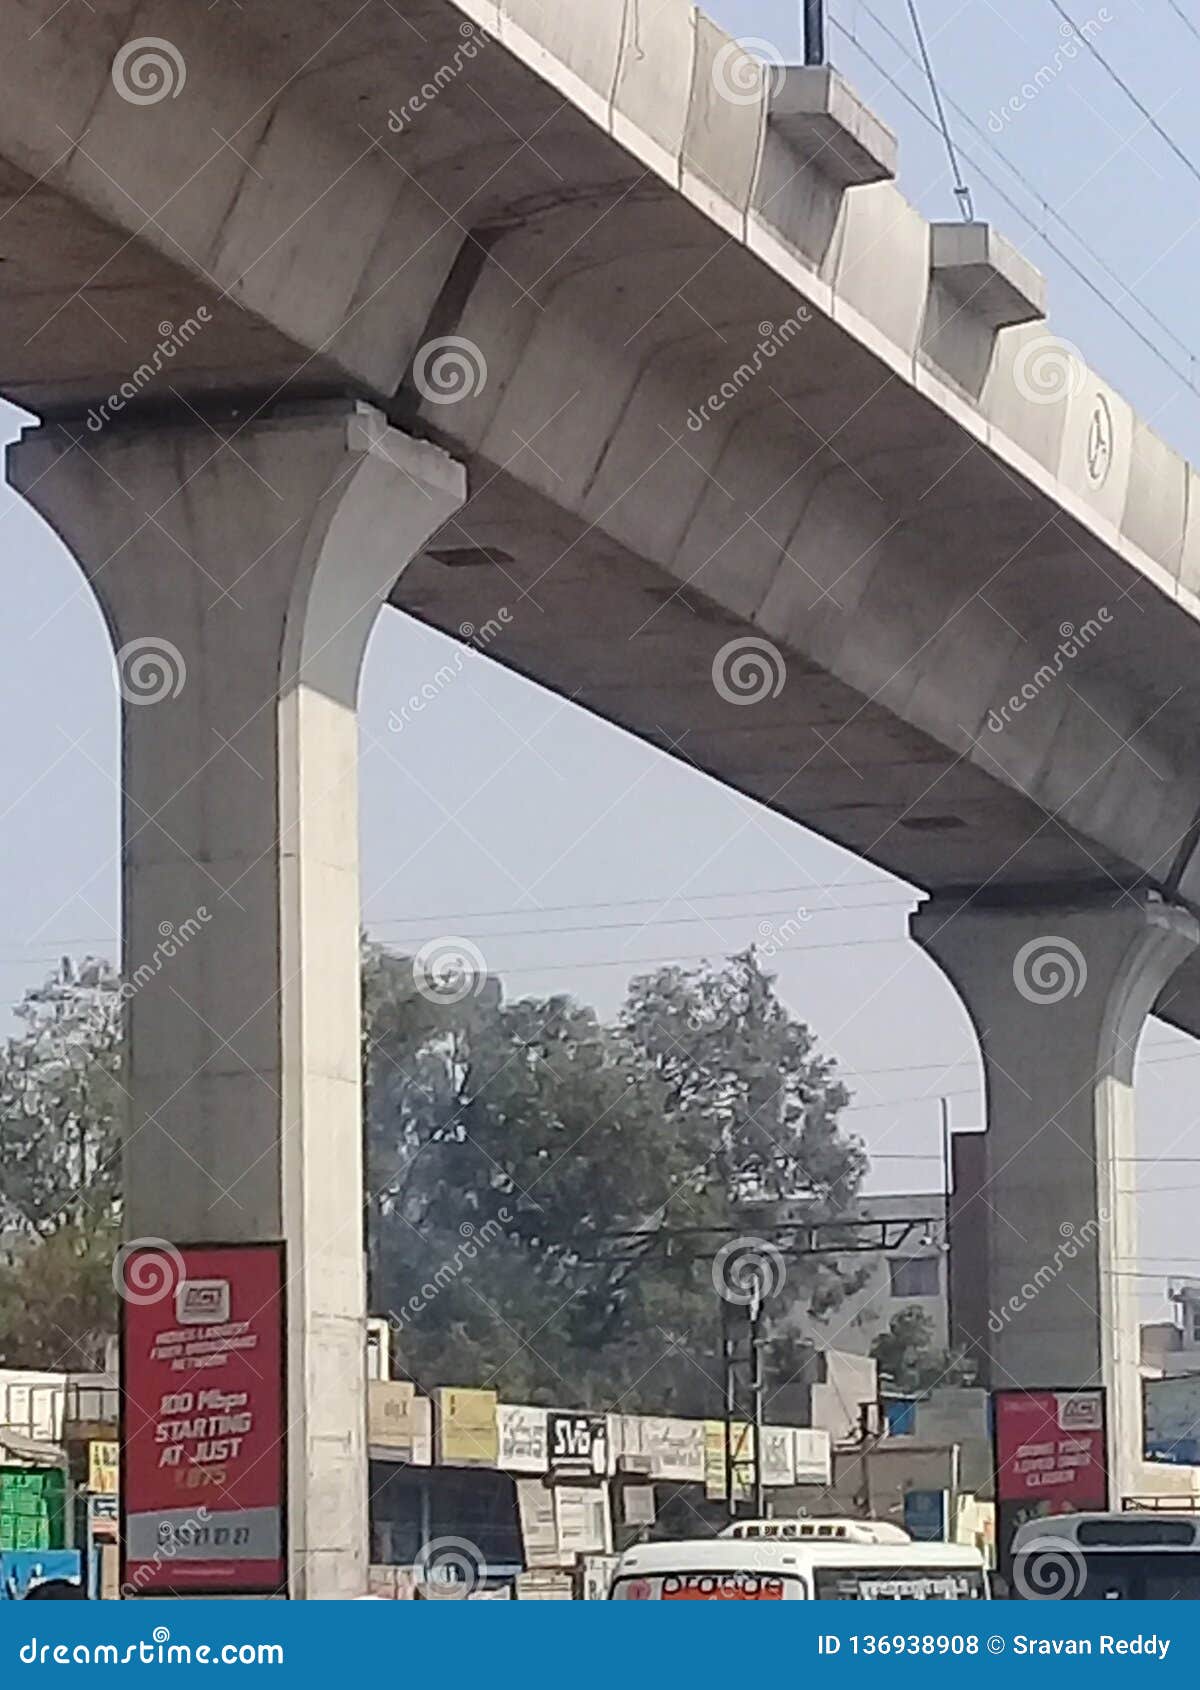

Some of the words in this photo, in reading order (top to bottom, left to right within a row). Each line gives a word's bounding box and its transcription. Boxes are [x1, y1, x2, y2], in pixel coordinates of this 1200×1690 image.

[160, 1392, 193, 1415] 100
[154, 1412, 252, 1443] STARTING
[159, 1445, 184, 1467] AT
[188, 1438, 242, 1463] JUST
